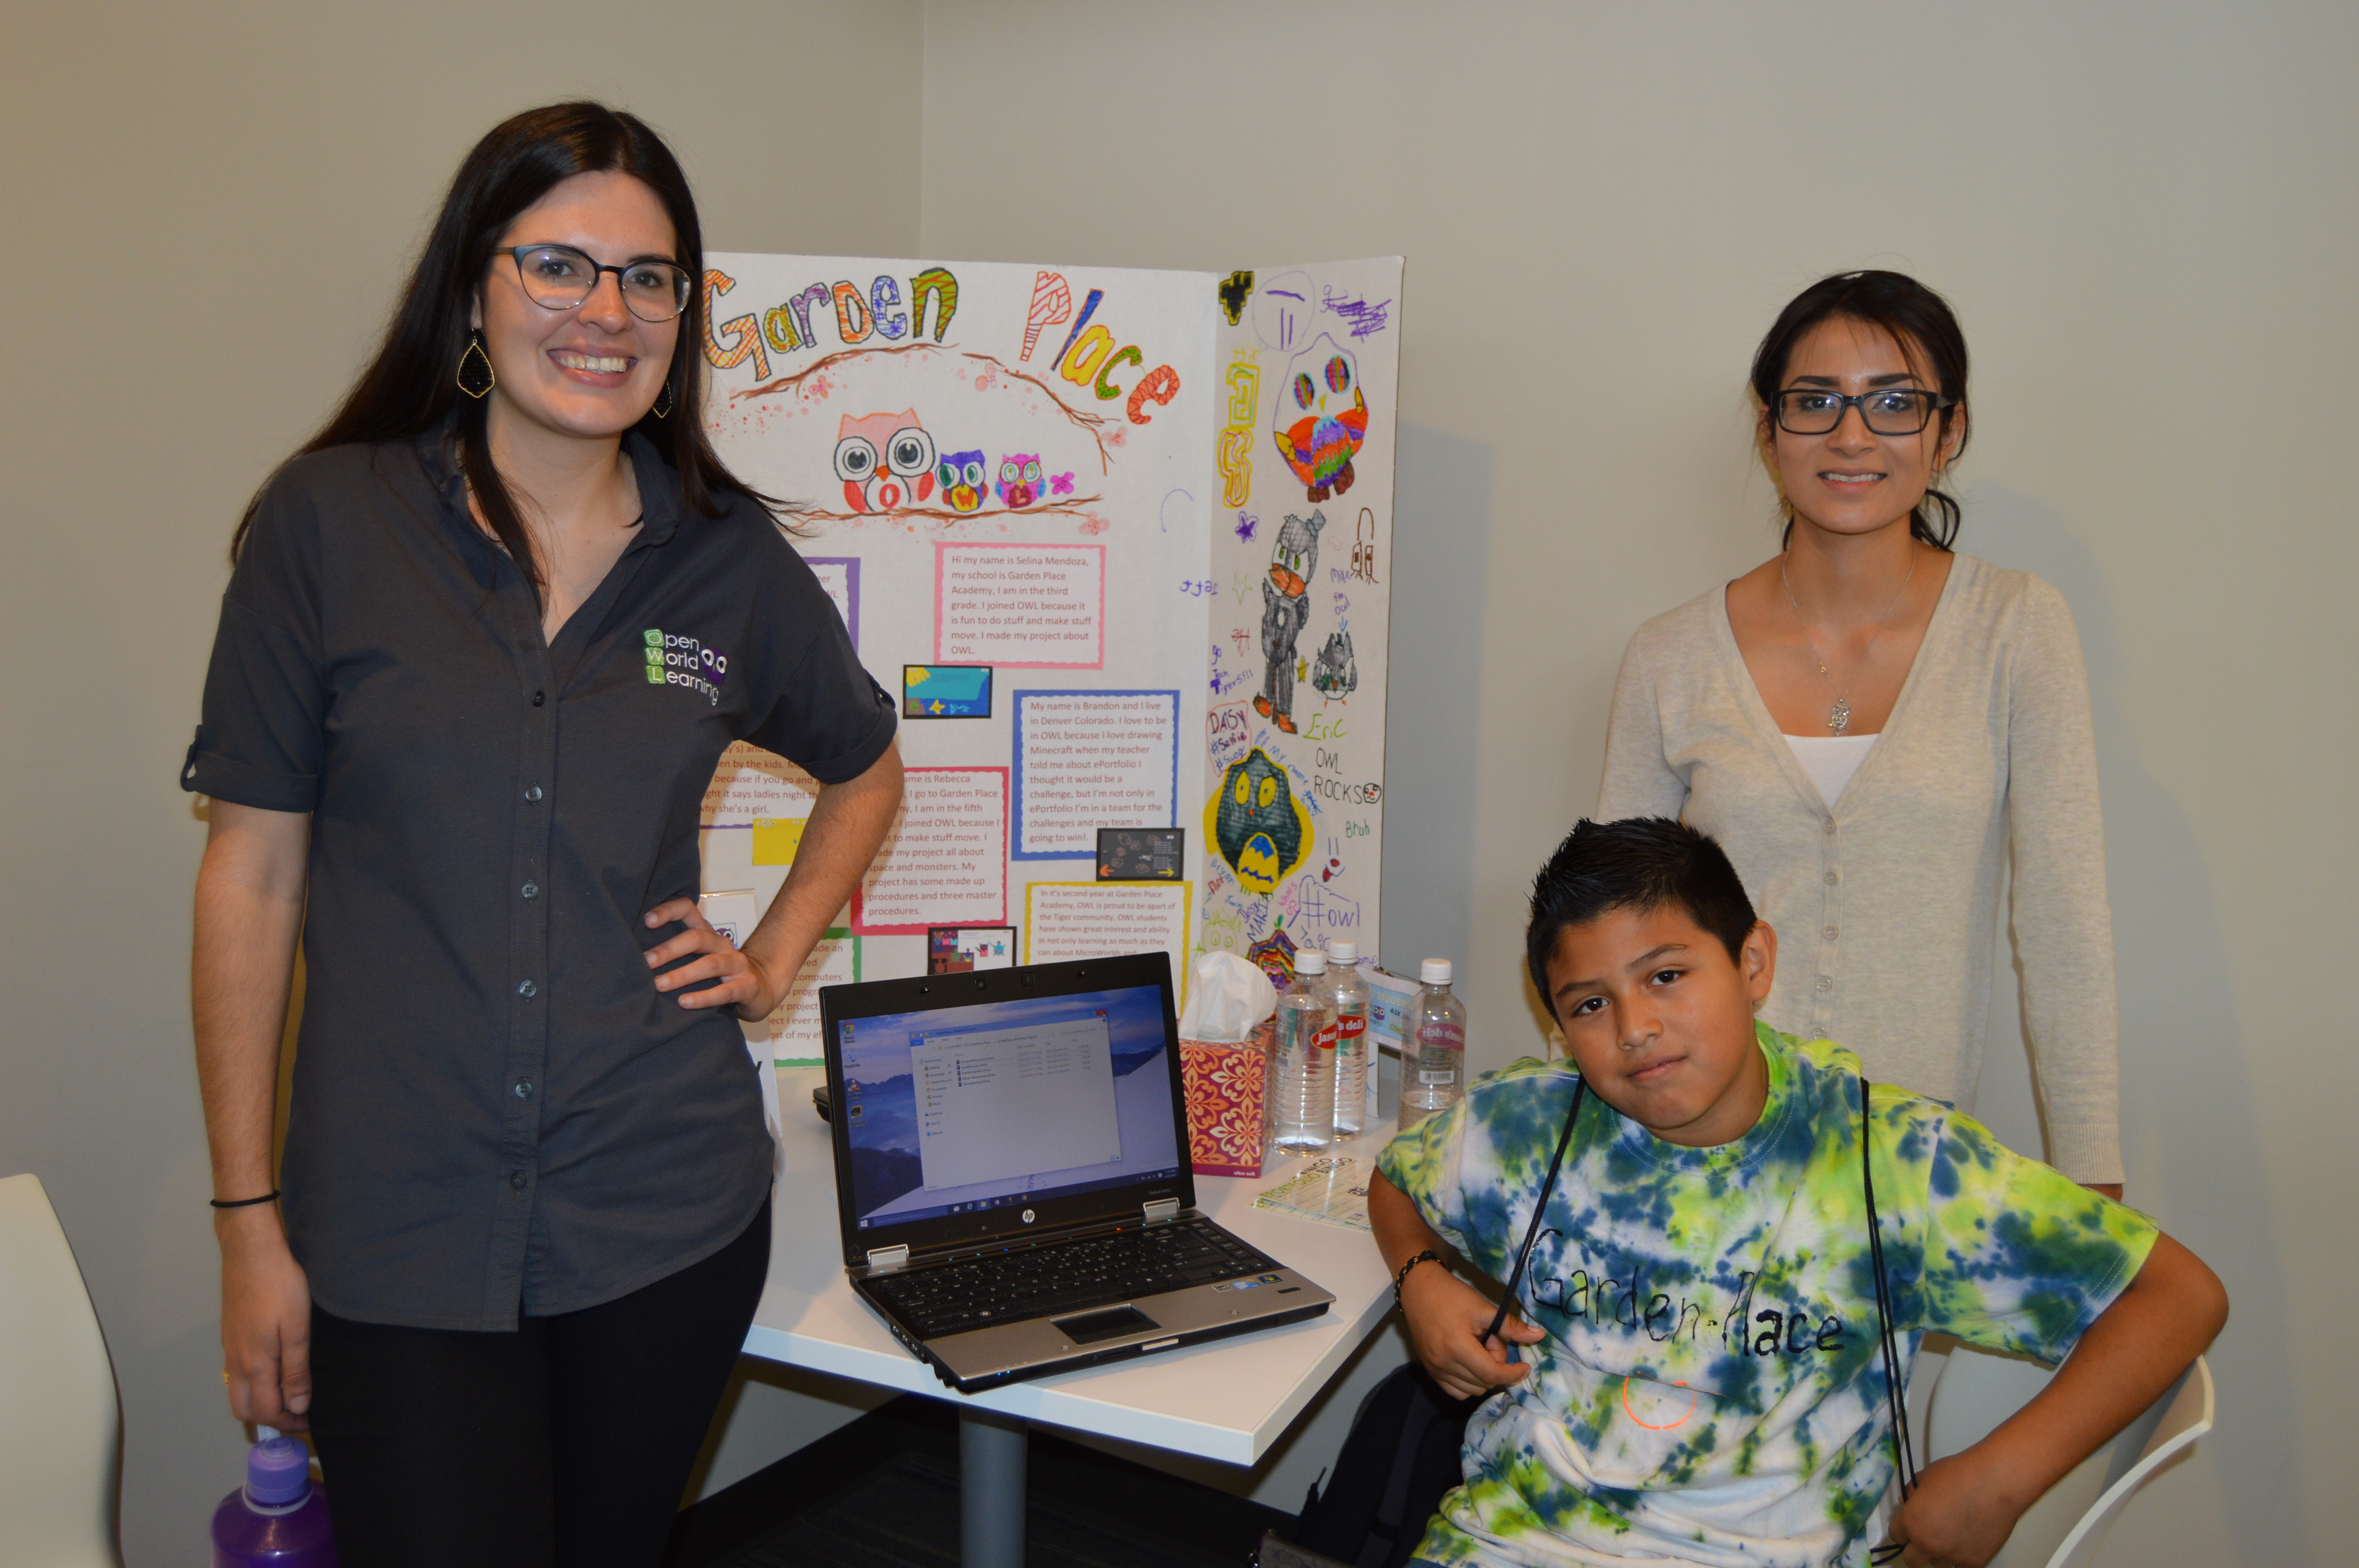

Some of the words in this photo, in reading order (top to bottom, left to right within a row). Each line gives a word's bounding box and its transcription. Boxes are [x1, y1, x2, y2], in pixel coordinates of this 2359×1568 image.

[1020, 270, 1181, 425] Place
[1046, 557, 1089, 566] Mendoza,
[968, 571, 997, 579] school
[1008, 571, 1040, 580] Garden
[952, 586, 995, 596] Academy,
[1030, 586, 1044, 595] the
[952, 601, 979, 611] grade.
[987, 602, 1015, 611] joined
[1041, 602, 1077, 610] because
[960, 616, 975, 624] fun
[1003, 616, 1024, 625] stuff
[1072, 617, 1092, 625] stuff
[646, 631, 700, 652] Open
[1030, 632, 1061, 641] project
[951, 646, 975, 654] OWL.
[1212, 645, 1222, 665] go
[646, 648, 698, 670] World
[651, 667, 719, 706] Learning
[1030, 702, 1045, 711] My
[1156, 716, 1166, 724] be
[1128, 731, 1162, 741] drawing
[1030, 746, 1072, 754] Minecraft
[1117, 745, 1150, 754] teacher
[734, 760, 742, 769] by
[1316, 747, 1343, 775] OWL
[1314, 775, 1362, 804] ROCKS
[783, 791, 806, 800] night
[752, 805, 769, 814] girl.
[1346, 819, 1370, 838] Bruh
[912, 849, 943, 858] project
[946, 848, 956, 856] all
[868, 865, 894, 873] space
[962, 863, 976, 871] My
[869, 878, 900, 887] project
[869, 893, 919, 902] procedures
[869, 907, 921, 917] procedures.
[795, 974, 842, 984] computers
[787, 1003, 819, 1012] project
[1346, 1019, 1364, 1030] deli
[786, 1031, 795, 1039] of
[1023, 1209, 1035, 1223] hp
